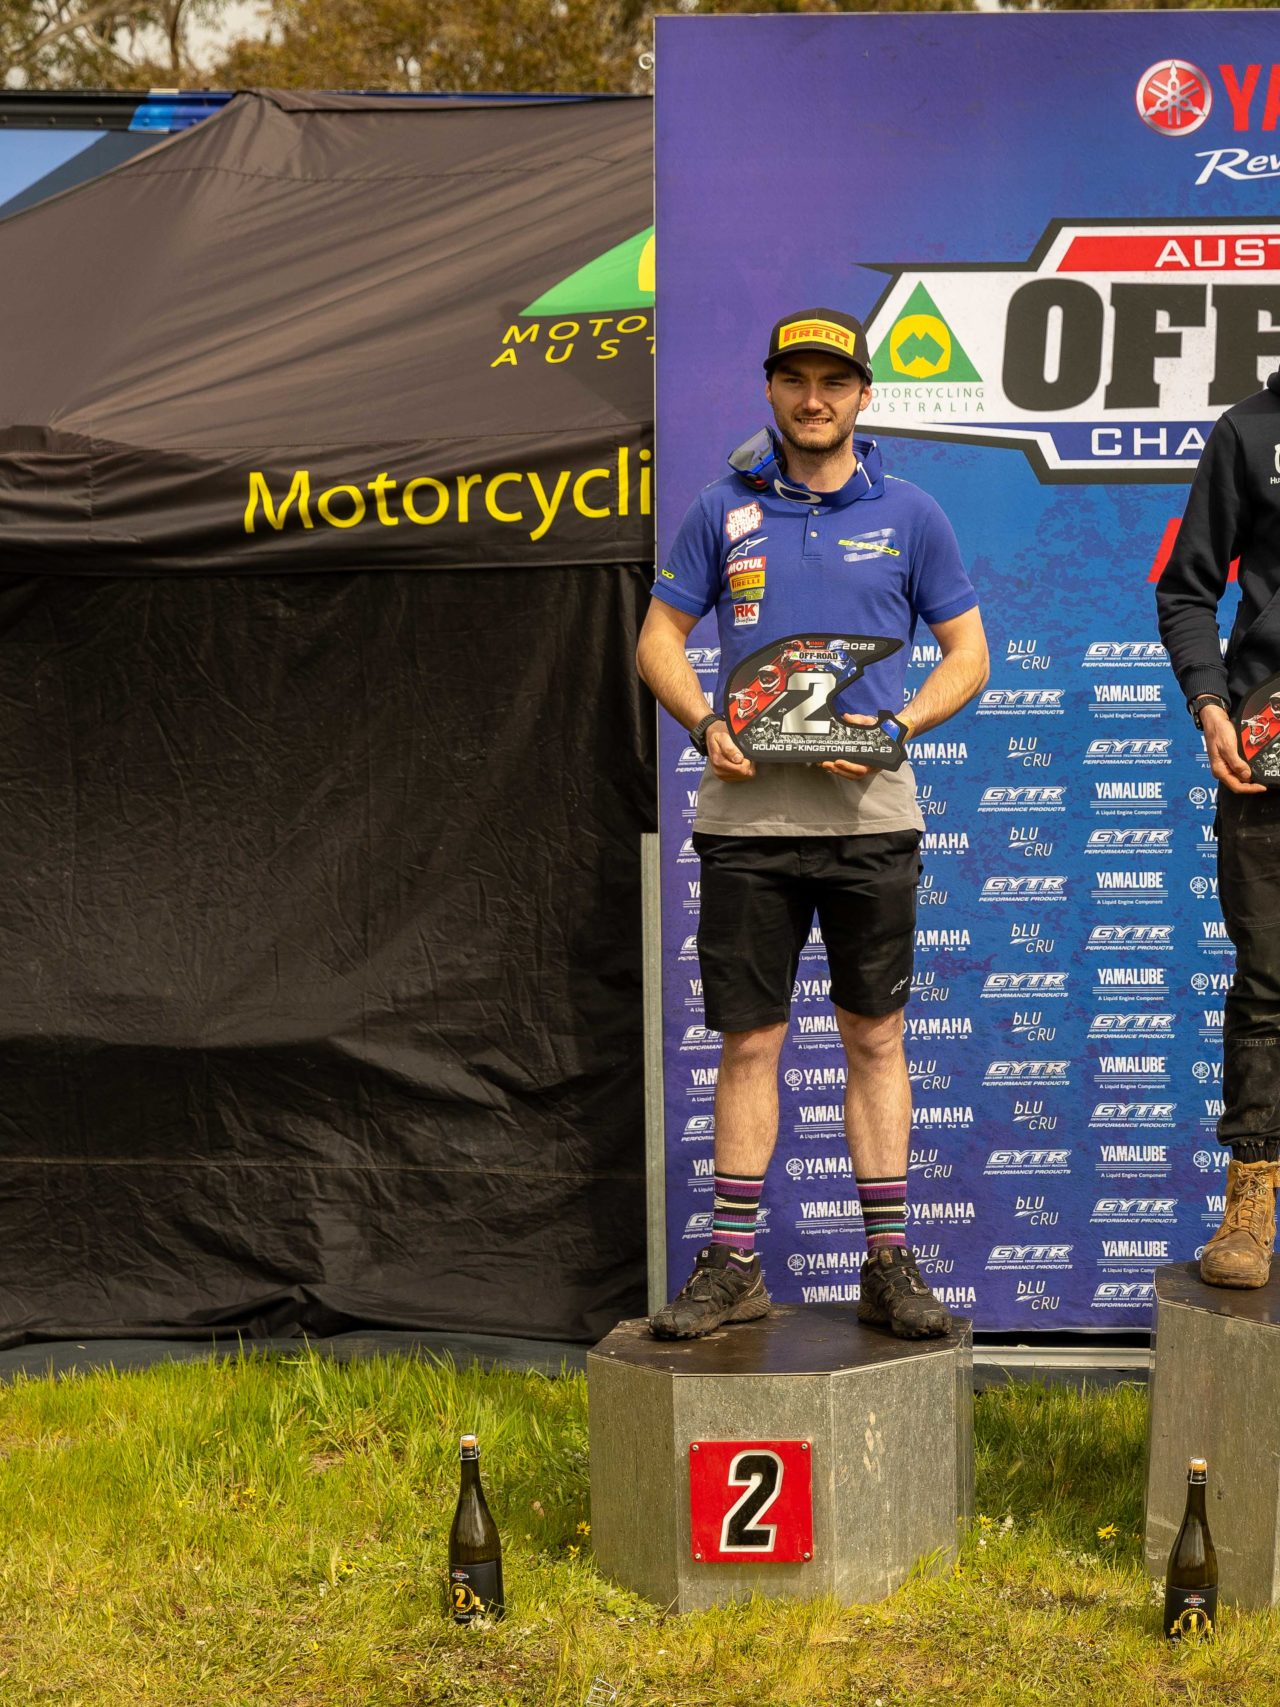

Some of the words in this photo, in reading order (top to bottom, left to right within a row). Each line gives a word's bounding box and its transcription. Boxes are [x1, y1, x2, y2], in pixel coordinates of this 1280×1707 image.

[784, 324, 850, 347] PIRELLI
[872, 387, 984, 398] OTORCYCLING
[872, 402, 985, 412] USTRALIA
[728, 559, 763, 575] MOTUL
[732, 575, 761, 589] PIRELLI
[735, 604, 757, 617] RK
[842, 642, 876, 651] 2022
[799, 652, 838, 660] OFF-ROAD
[980, 690, 1064, 705] GYTR
[1094, 685, 1160, 701] YAMALUBE
[781, 672, 837, 734] 2
[752, 743, 784, 751] ROUND
[798, 744, 844, 752] KINGSTON
[861, 745, 874, 753] SA
[1088, 739, 1172, 754] GYTR
[1095, 782, 1162, 798] YAMALUBE
[983, 876, 1068, 891] GYTR
[1097, 871, 1163, 888] YAMALUBE
[1098, 968, 1164, 984] YAMALUBE
[986, 1061, 1070, 1075] GYTR
[1100, 1145, 1166, 1161] YAMALUBE
[1094, 1199, 1178, 1214] GYTR
[719, 1449, 784, 1553] 2
[455, 1588, 466, 1608] 2
[1189, 1613, 1197, 1633] 1
